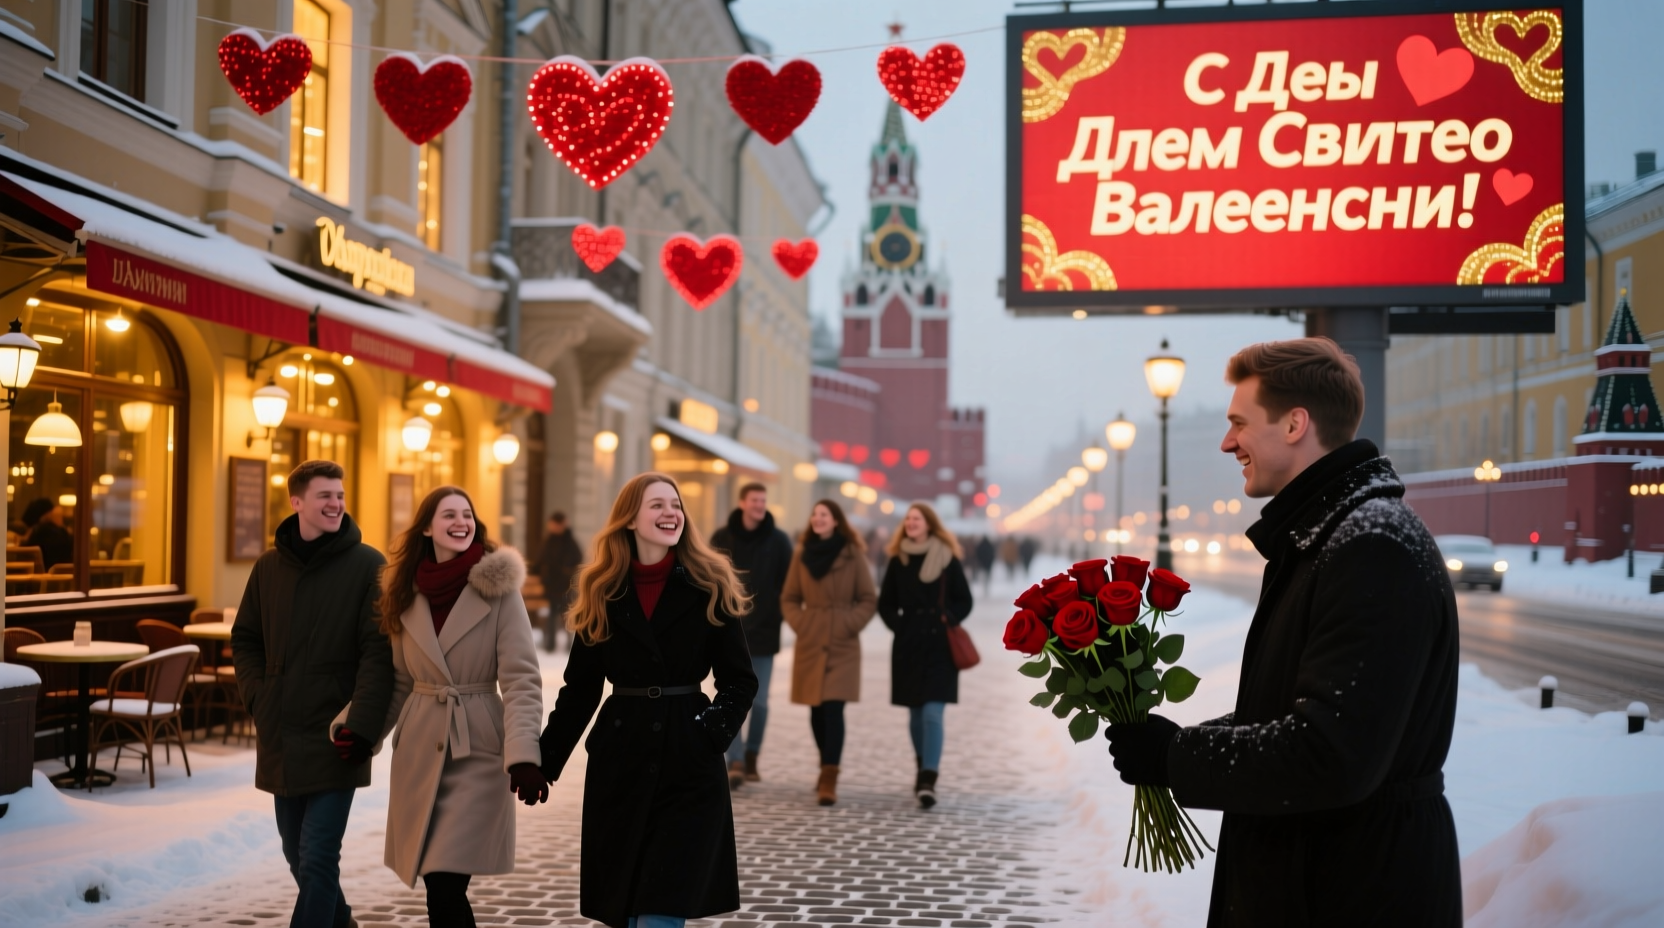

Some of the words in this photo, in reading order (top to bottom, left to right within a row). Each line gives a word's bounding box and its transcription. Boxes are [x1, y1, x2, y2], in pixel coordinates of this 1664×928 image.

[1234, 50, 1379, 113] Деы
[1056, 115, 1243, 183] Длем
[1258, 111, 1513, 169] Свитео
[1090, 172, 1481, 236] Валеенсни!
